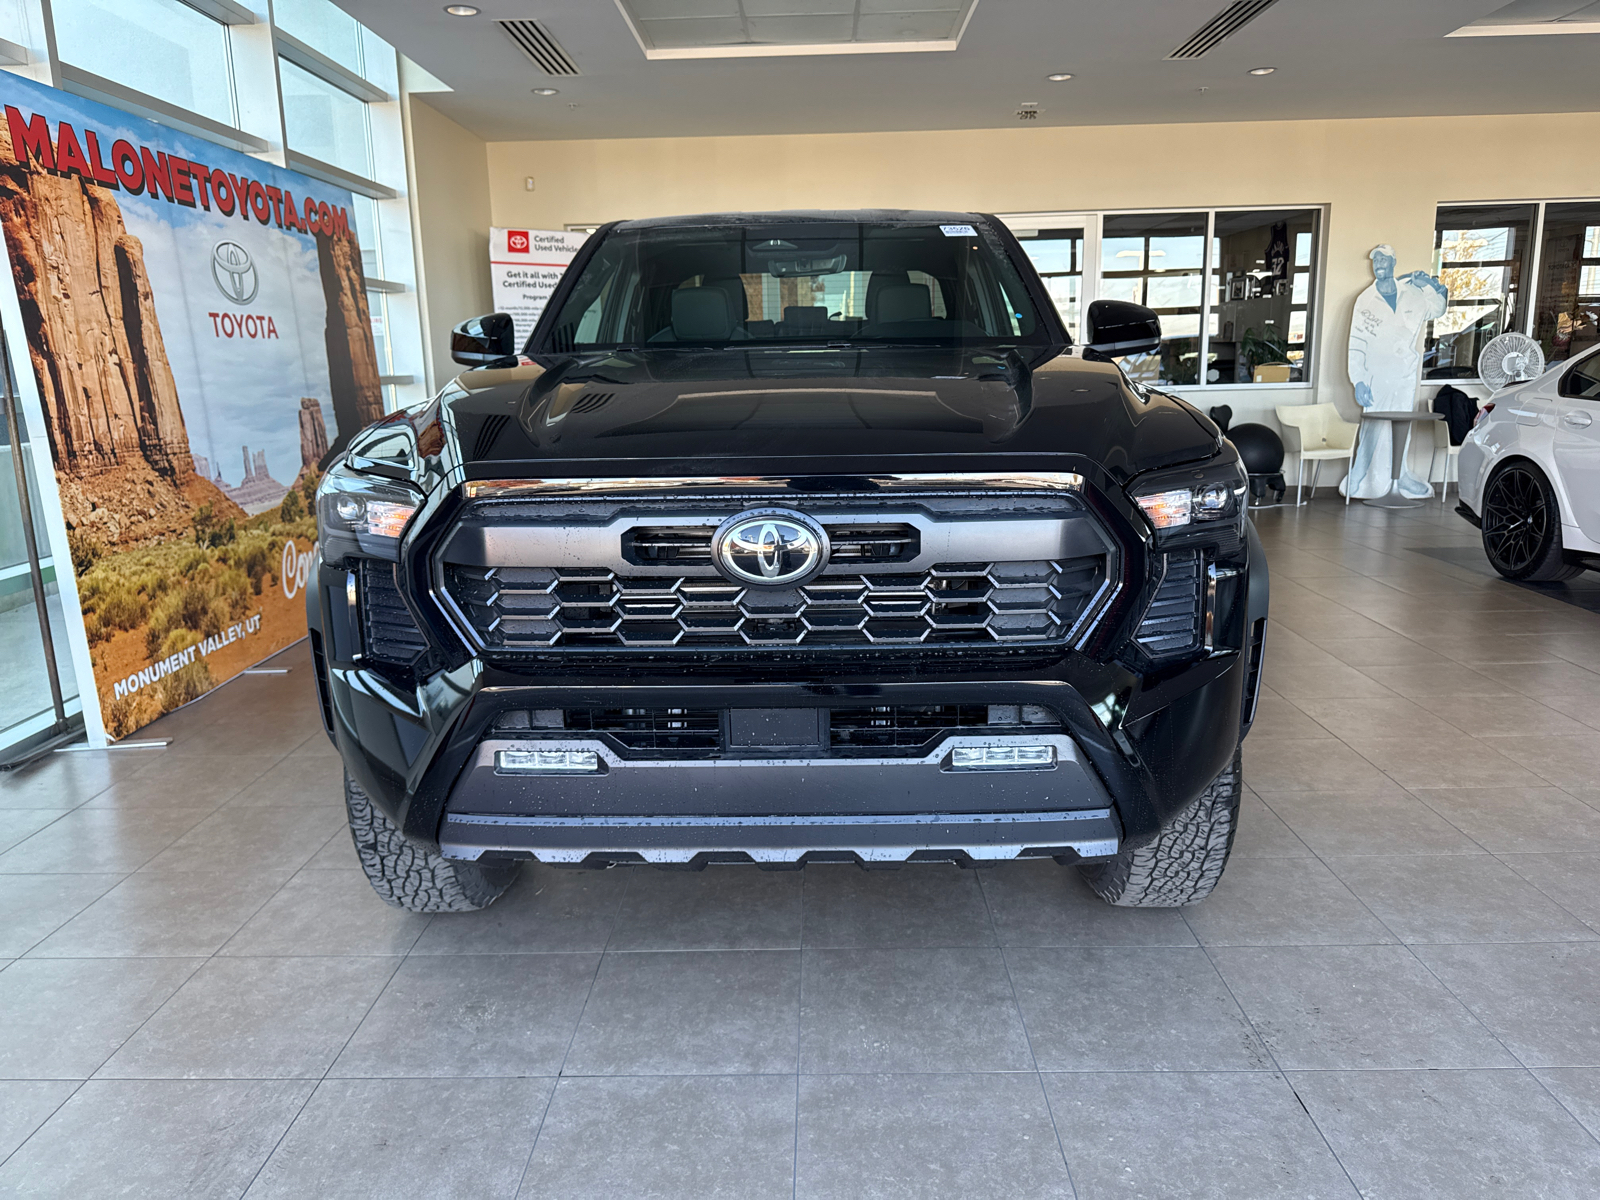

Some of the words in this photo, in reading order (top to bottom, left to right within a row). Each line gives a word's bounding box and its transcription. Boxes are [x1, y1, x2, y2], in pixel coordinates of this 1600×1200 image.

[4, 104, 350, 239] MALONETOYOTA.COM
[533, 235, 565, 244] Certified
[534, 244, 553, 252] Used
[554, 245, 580, 253] Vehicle
[506, 271, 521, 279] Get
[522, 271, 529, 279] it
[541, 272, 559, 280] with
[208, 311, 279, 340] TOYOTA
[113, 645, 197, 700] MONUMENT
[198, 622, 246, 657] VALLEY,
[246, 614, 262, 635] UT
